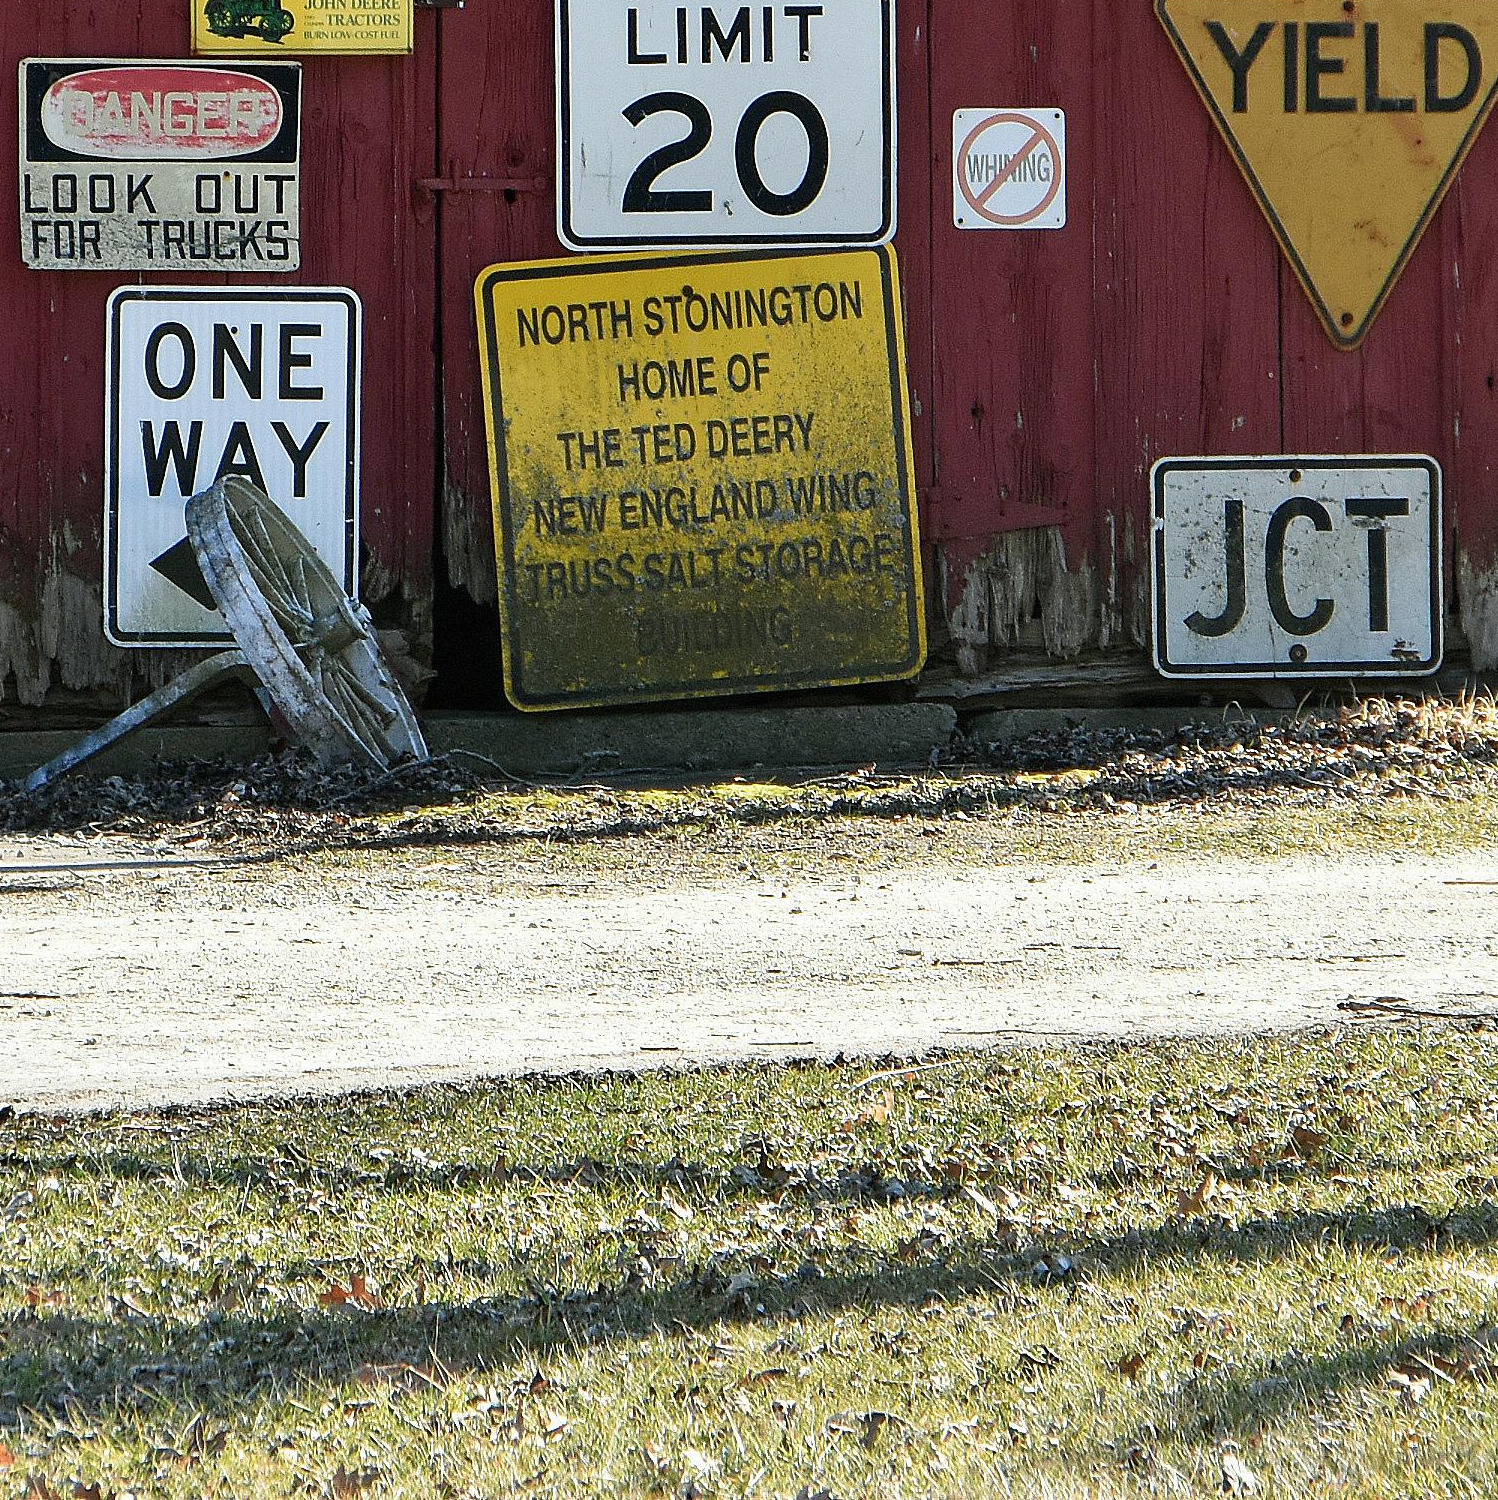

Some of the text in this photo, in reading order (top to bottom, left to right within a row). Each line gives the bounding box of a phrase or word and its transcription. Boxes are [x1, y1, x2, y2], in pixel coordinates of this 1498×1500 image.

[304, 31, 329, 39] BURN
[381, 31, 400, 39] FUEL
[326, 14, 400, 27] TRACTORS
[626, 6, 823, 64] LIMIT
[1203, 21, 1484, 114] YIELD
[63, 91, 263, 138] DANGER
[621, 90, 829, 217] 20
[24, 173, 296, 215] LOOK OUT
[32, 220, 290, 260] FOR TRUCKS
[517, 280, 862, 347] NORTH STONINGTON
[145, 322, 324, 402] ONE
[617, 352, 770, 402] HOME OF
[140, 420, 330, 499] WAY
[557, 413, 815, 471] THE TED DEERY
[533, 471, 875, 538] NEW ENGLAND WING
[526, 534, 893, 600] TRUSS SALT STORAGE
[1183, 496, 1409, 637] JCT
